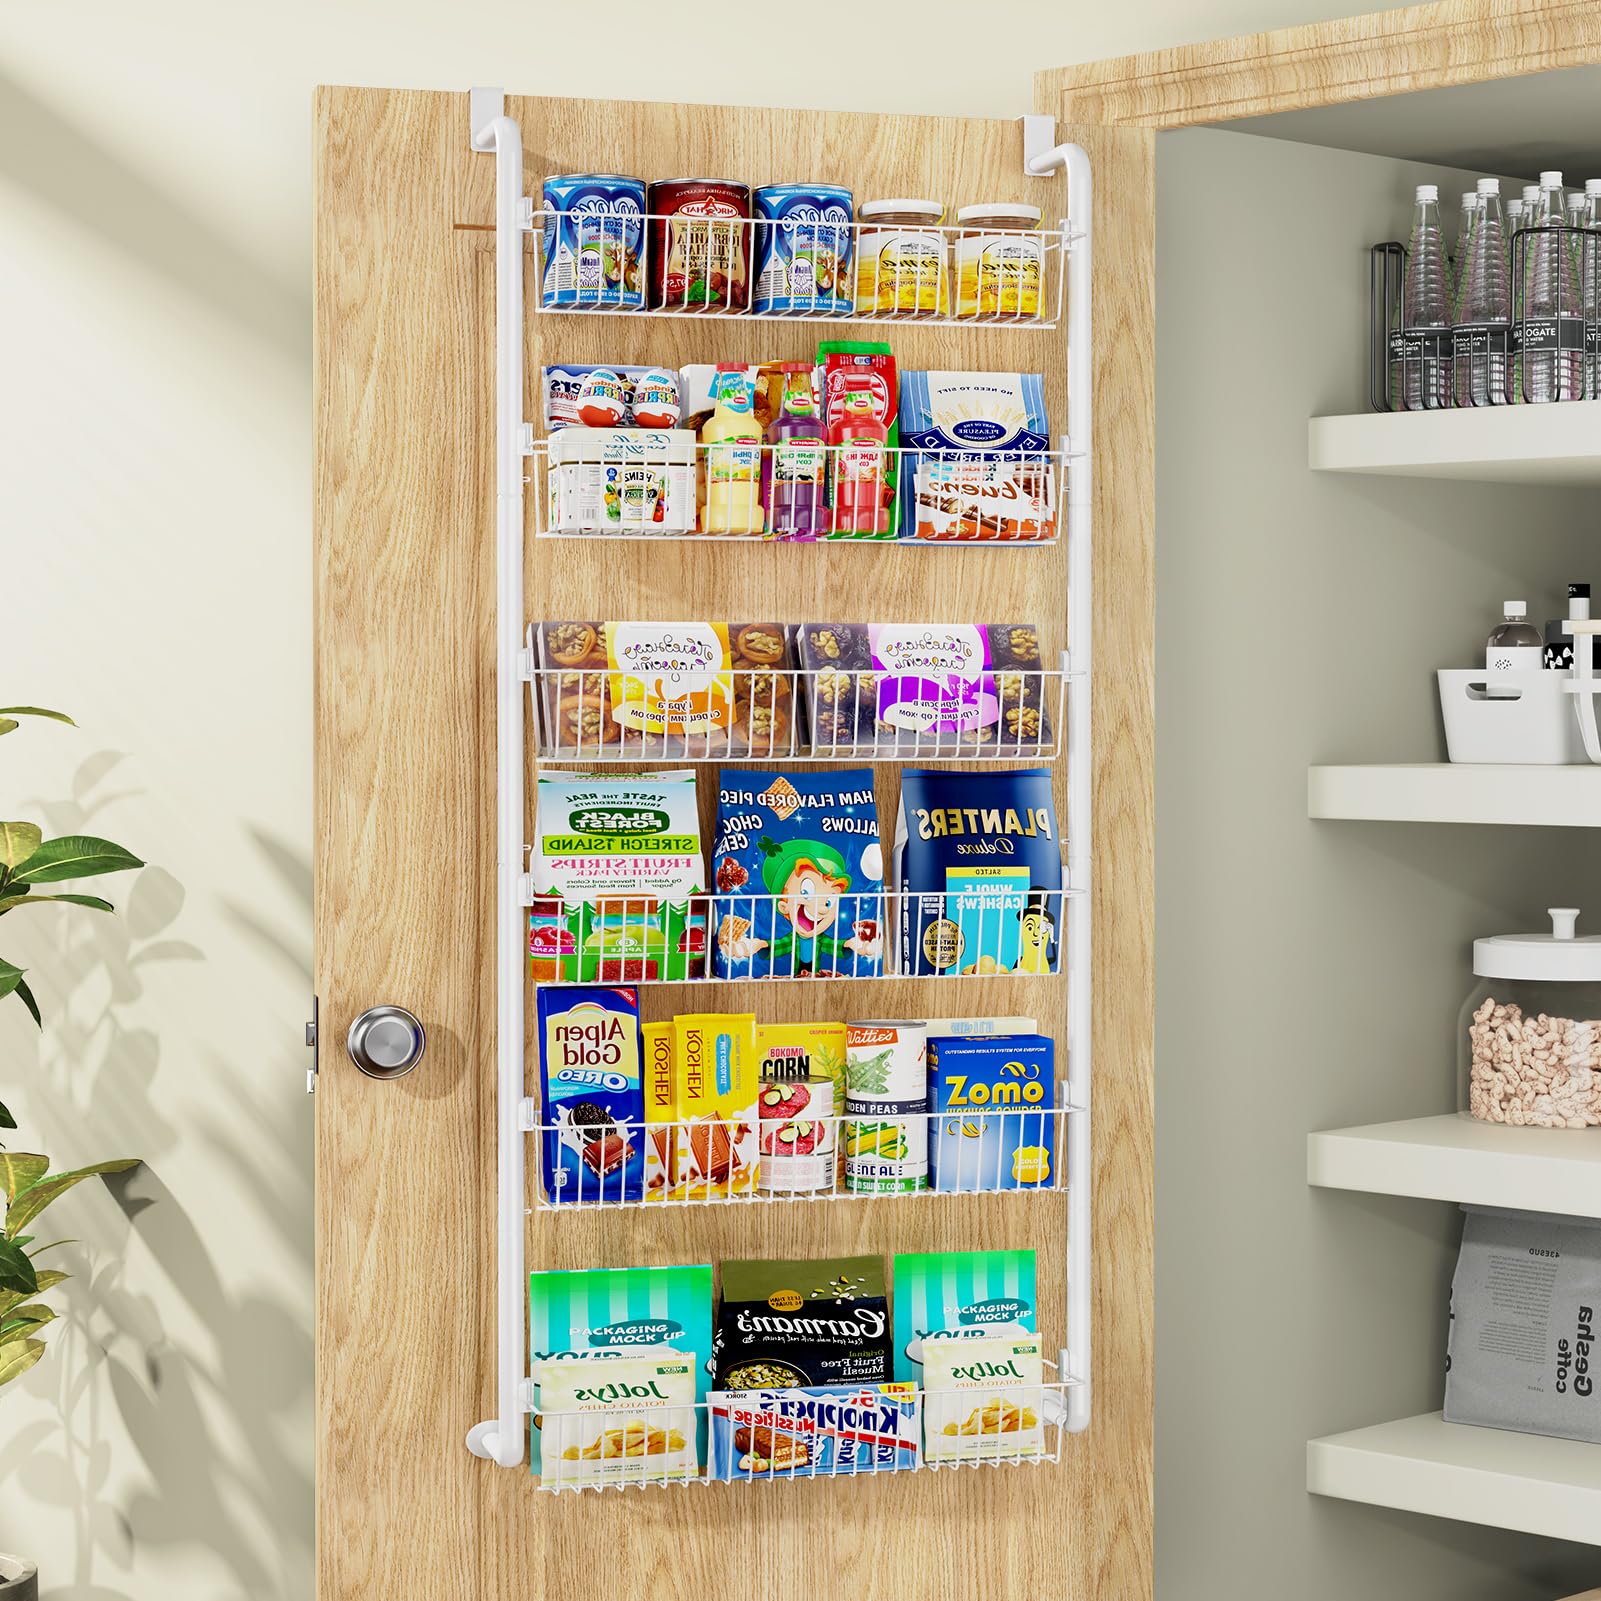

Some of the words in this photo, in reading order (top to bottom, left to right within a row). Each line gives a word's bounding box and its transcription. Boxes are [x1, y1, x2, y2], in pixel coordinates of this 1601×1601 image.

[846, 1029, 894, 1047] Wattie's
[770, 1047, 804, 1059] BOKOMO
[762, 1055, 811, 1079] CORN
[945, 1075, 1045, 1106] Zomo
[870, 1104, 899, 1115] PEAS
[943, 1303, 1019, 1315] PACKAGING
[974, 1312, 1010, 1322] MOCK
[1014, 1310, 1033, 1319] UP
[569, 1324, 668, 1336] PACKAGING
[609, 1334, 657, 1344] MOCK
[663, 1331, 687, 1341] UP
